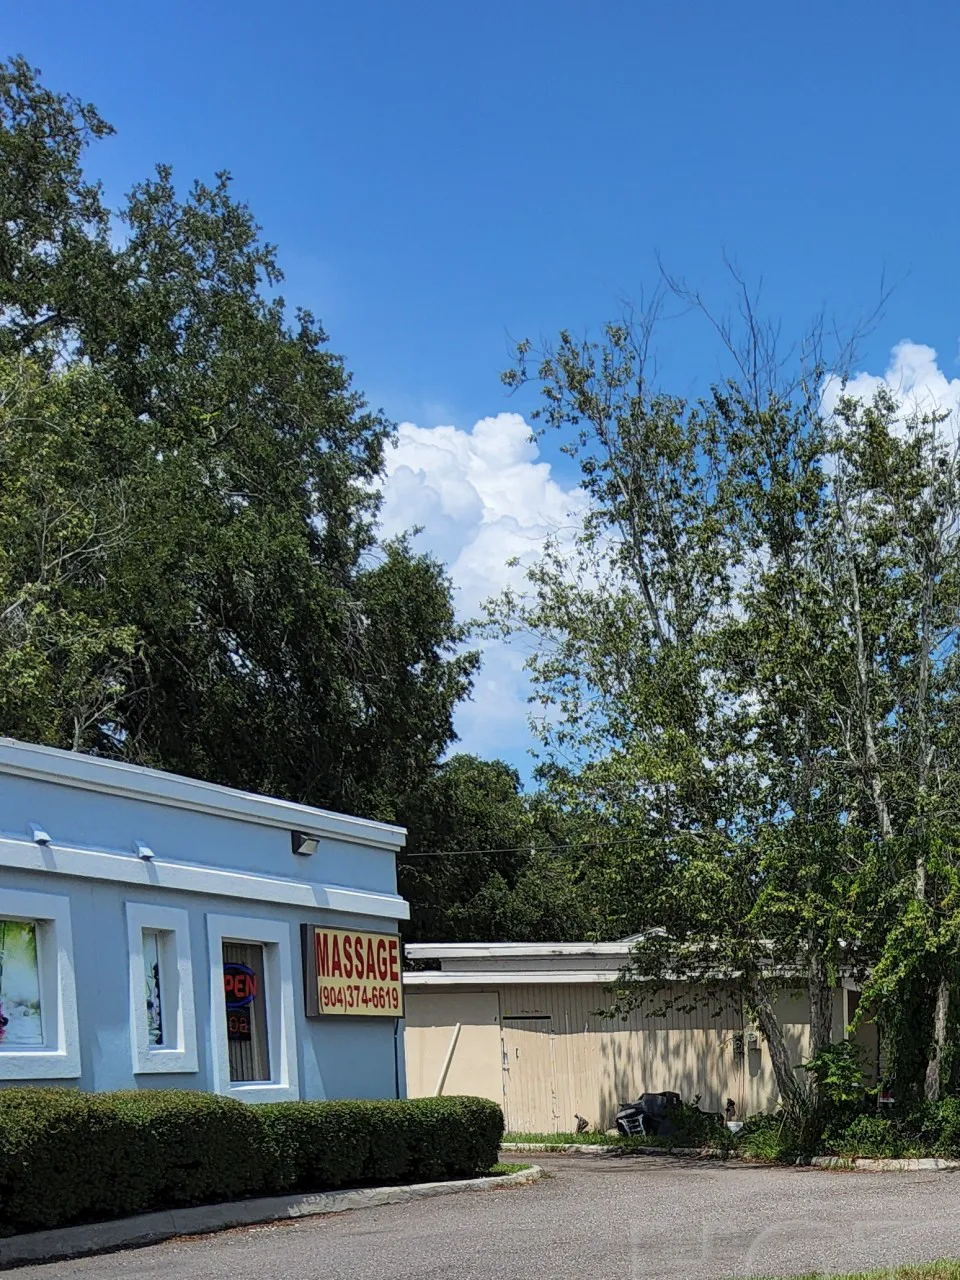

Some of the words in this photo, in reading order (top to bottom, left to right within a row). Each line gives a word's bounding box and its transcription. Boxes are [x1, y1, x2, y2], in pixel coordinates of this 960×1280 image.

[315, 932, 399, 982] MASSAGE
[223, 974, 258, 997] PEN
[319, 984, 399, 1013] (904)374-6619
